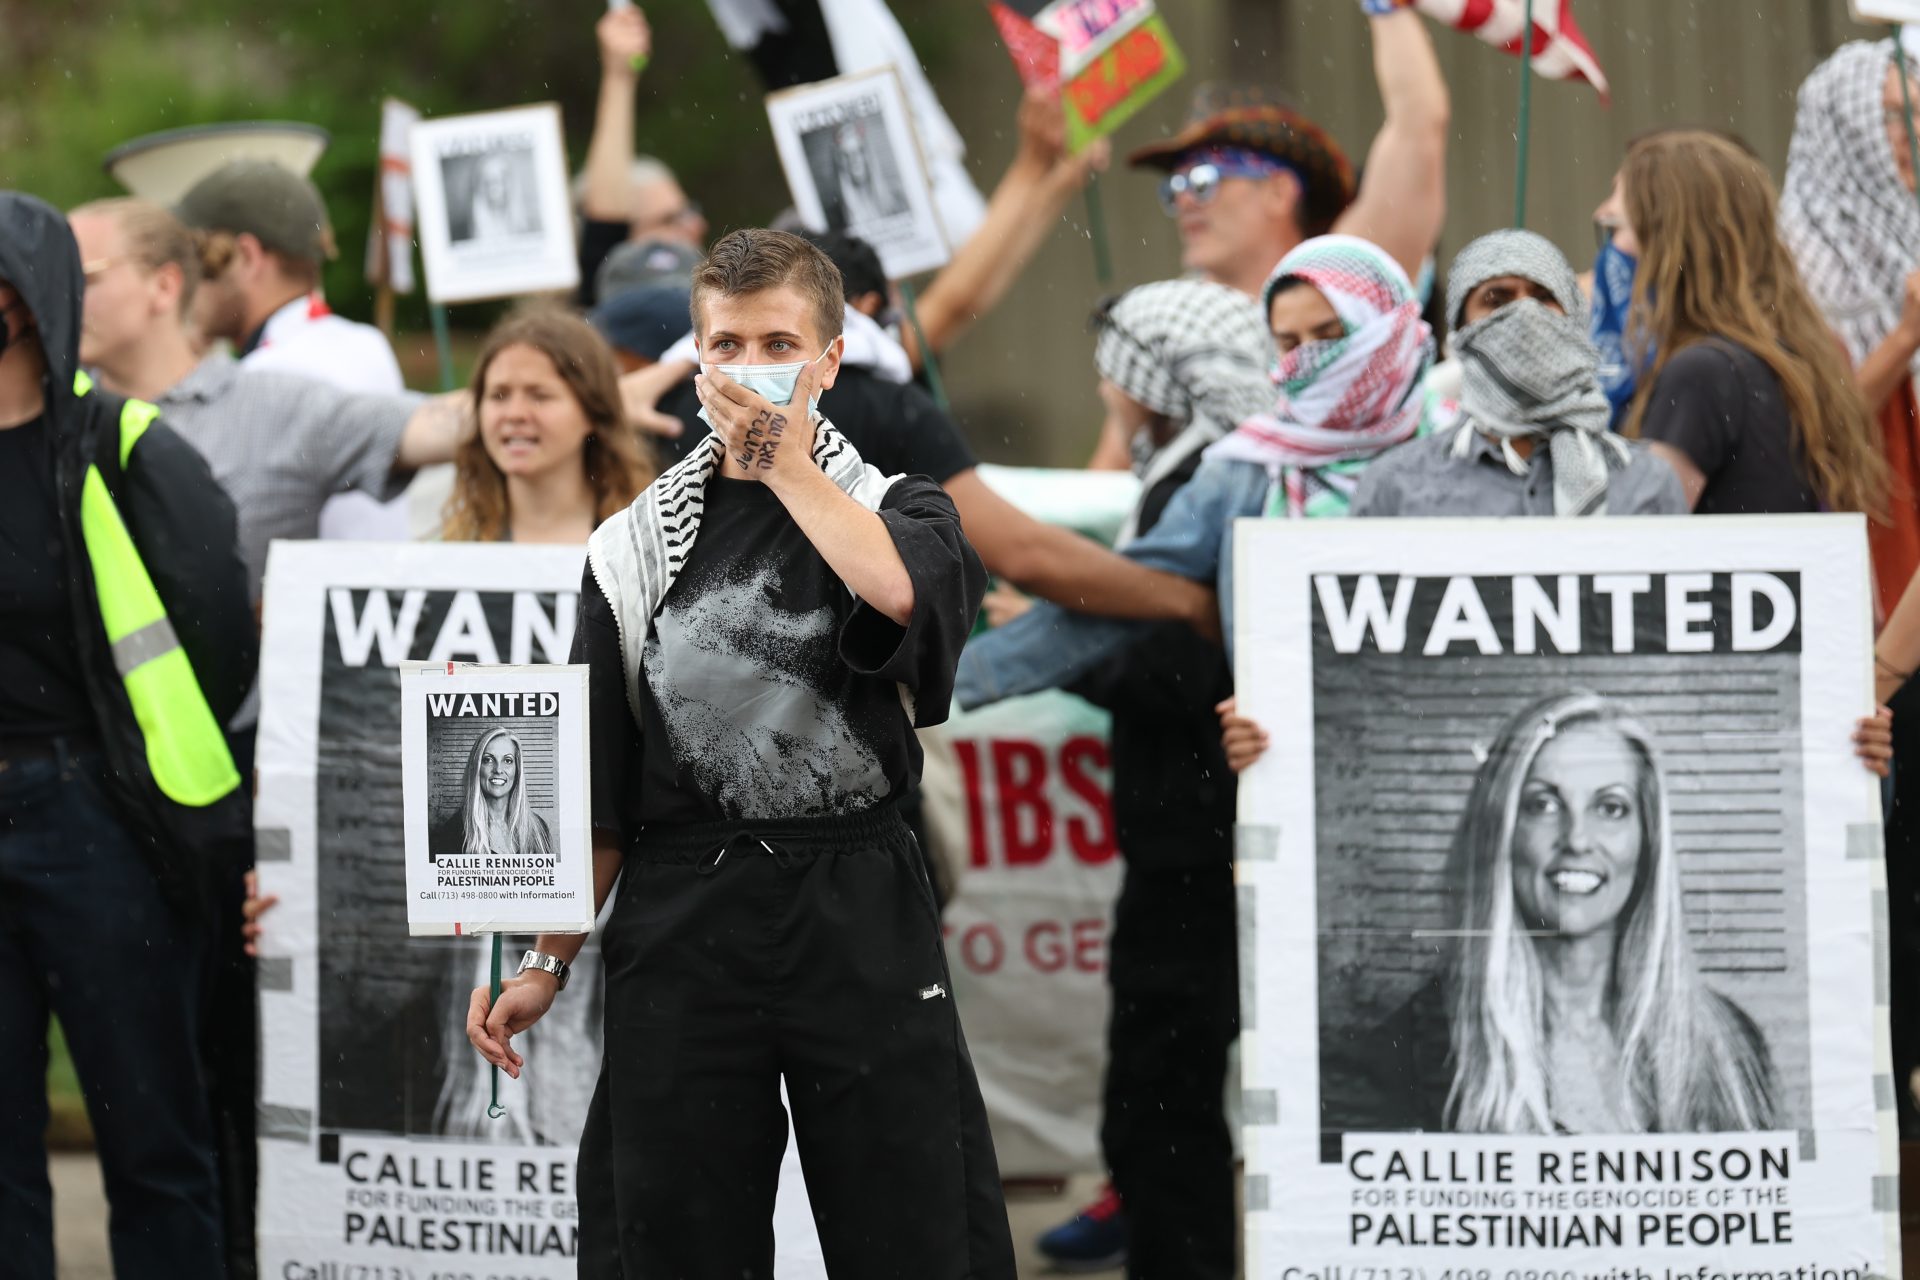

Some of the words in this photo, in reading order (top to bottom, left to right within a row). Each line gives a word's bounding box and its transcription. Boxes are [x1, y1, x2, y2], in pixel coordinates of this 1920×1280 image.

[328, 588, 578, 666] WAN
[1314, 572, 1797, 655] WANTED
[428, 693, 557, 717] WANTED
[952, 734, 1119, 867] IBS
[437, 858, 480, 868] CALLIE
[486, 858, 554, 868] RENNISON
[420, 891, 436, 899] Call
[438, 891, 458, 900] (713)
[461, 891, 498, 899] 498-0800
[500, 891, 518, 899] with
[521, 891, 575, 899] Information!
[438, 876, 509, 886] PALESTINIAN
[513, 876, 554, 886] PEOPLE
[942, 922, 1004, 975] O
[1023, 919, 1105, 974] GE
[345, 1152, 495, 1191] CALLIE
[517, 1161, 577, 1194] RE
[1349, 1150, 1513, 1183] CALLIE
[1540, 1148, 1789, 1183] RENNISON
[345, 1189, 392, 1208] FOR
[396, 1192, 497, 1217] FUNDING
[504, 1199, 545, 1219] THE
[1352, 1189, 1397, 1206] FOR
[1404, 1189, 1515, 1208] FUNDING
[1523, 1190, 1568, 1209] THE
[1573, 1188, 1698, 1208] GENOCIDE
[1706, 1188, 1734, 1207] OF
[1743, 1186, 1788, 1205] THE
[1350, 1213, 1622, 1247] PALESTINIAN
[1639, 1211, 1792, 1246] PEOPLE
[283, 1260, 337, 1280] Call
